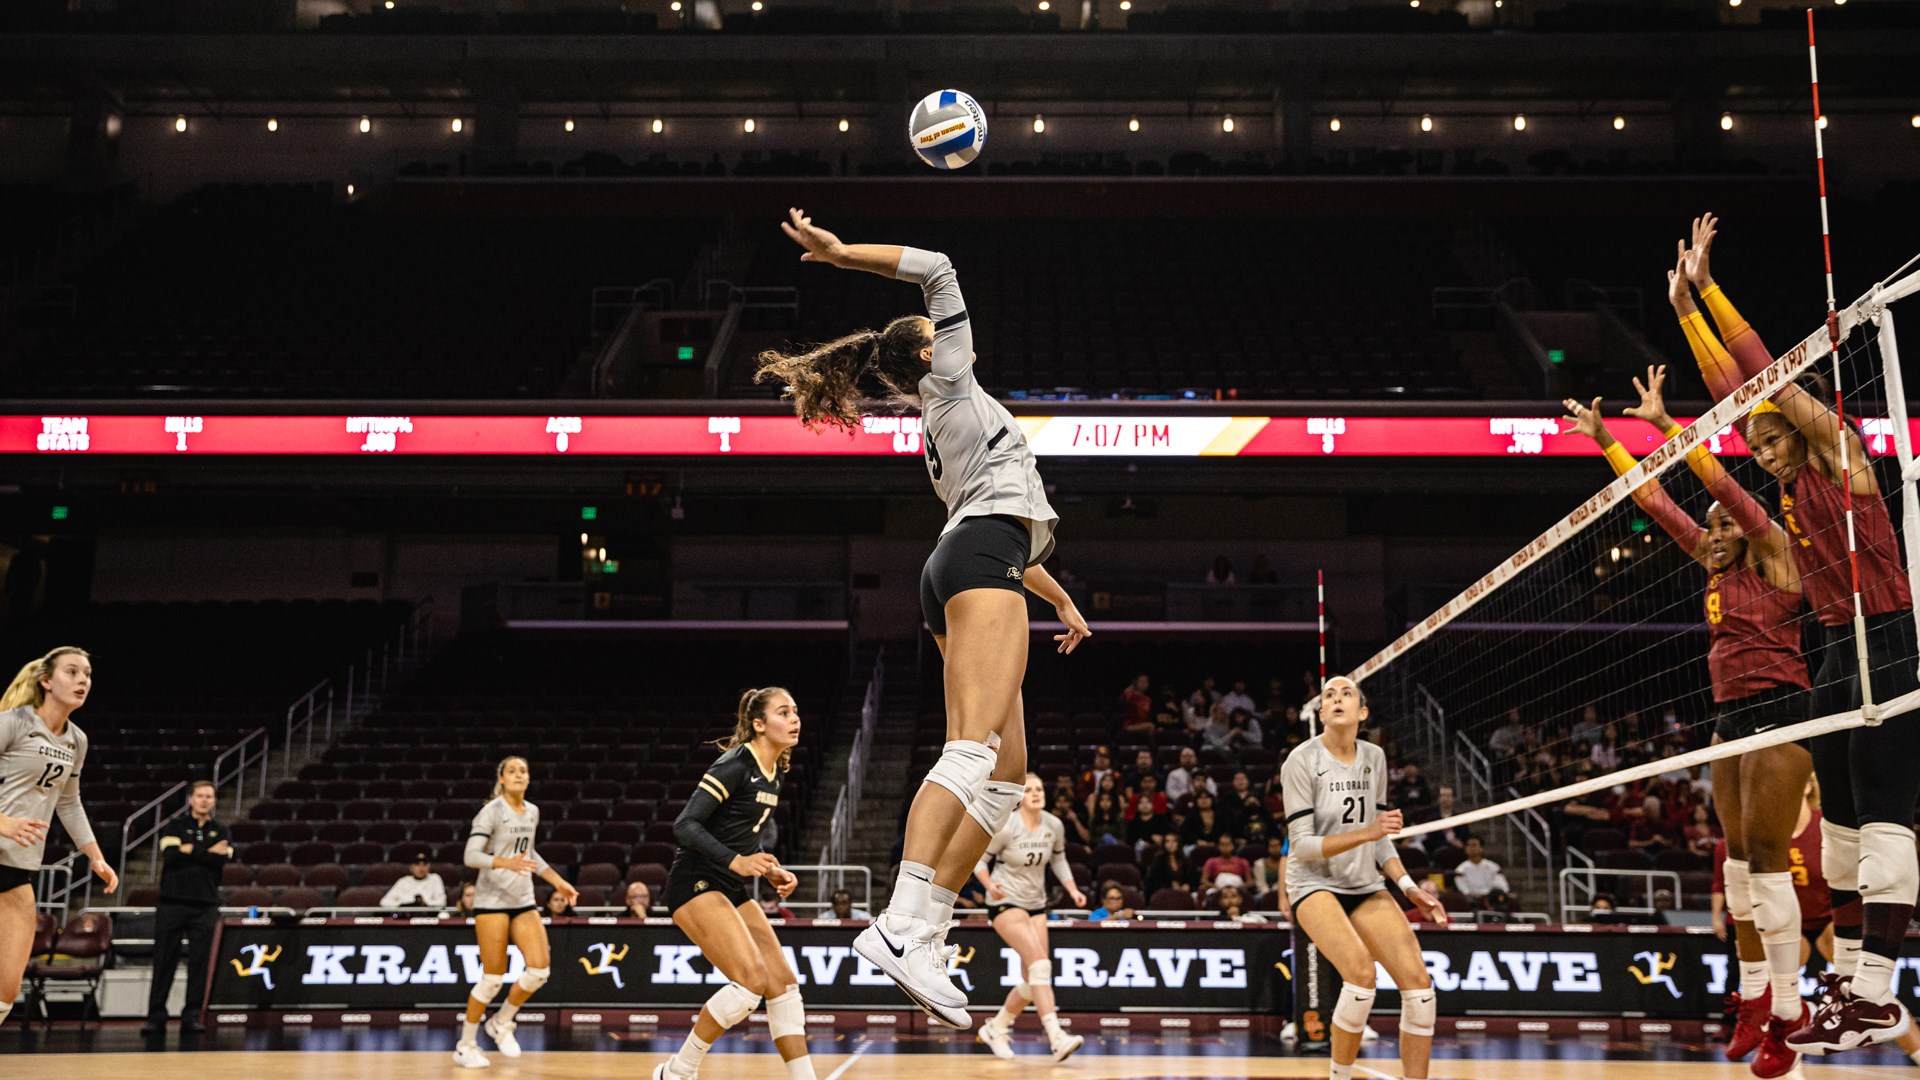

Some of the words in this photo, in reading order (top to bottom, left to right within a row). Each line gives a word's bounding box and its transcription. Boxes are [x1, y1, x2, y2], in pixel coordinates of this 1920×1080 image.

[941, 122, 966, 135] Women
[964, 100, 983, 142] molten
[920, 135, 934, 144] Troy
[933, 131, 941, 140] of
[1733, 375, 1765, 409] WOMEN
[1766, 362, 1779, 386] OF
[1781, 341, 1808, 377] TROY
[41, 417, 88, 434] TEAM
[37, 433, 90, 451] STATS
[1134, 425, 1170, 447] PM
[1640, 448, 1667, 477] WOMEN
[1680, 425, 1700, 450] TROY
[36, 762, 64, 788] 12
[1342, 796, 1365, 824] 21
[514, 836, 529, 854] 10
[1024, 852, 1043, 867] 31
[1421, 951, 1602, 991] RAVE
